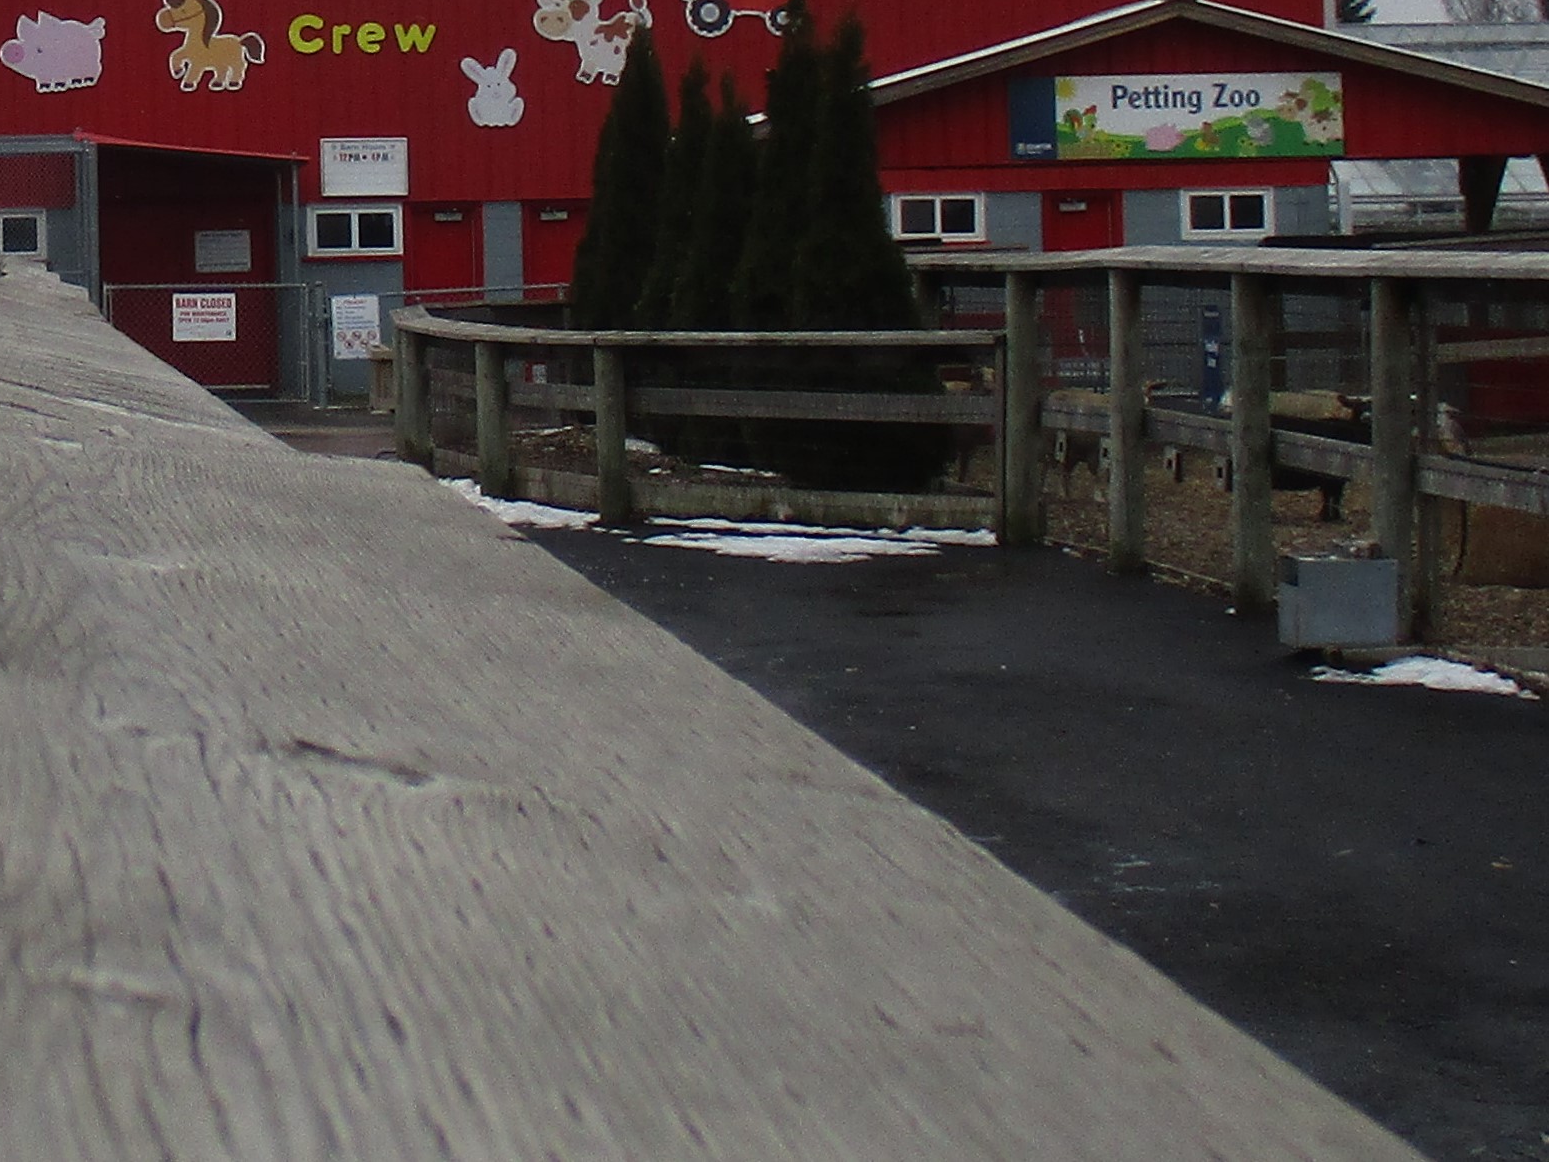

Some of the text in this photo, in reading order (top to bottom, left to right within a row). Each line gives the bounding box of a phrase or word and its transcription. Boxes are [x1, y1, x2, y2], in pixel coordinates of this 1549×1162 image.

[288, 14, 436, 54] Crew
[1111, 83, 1261, 114] Petting Zoo
[175, 298, 232, 309] BARN CLOSED
